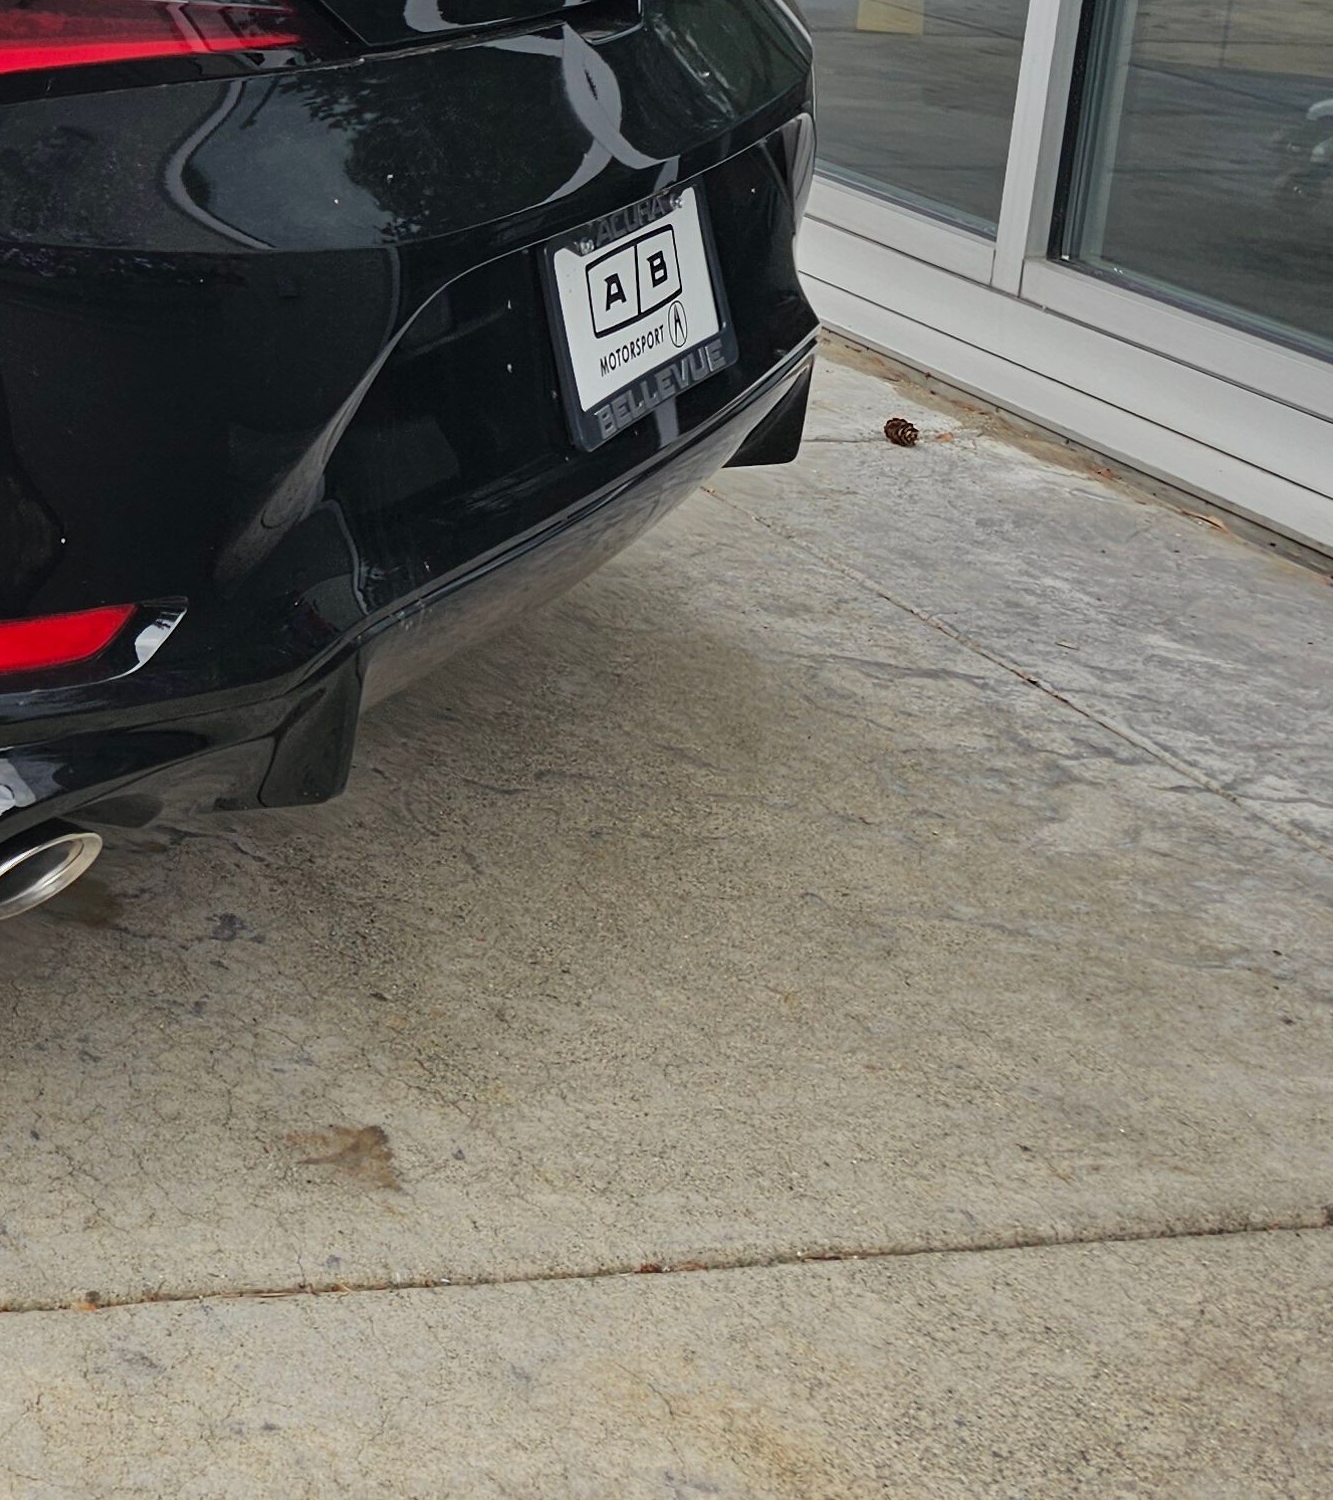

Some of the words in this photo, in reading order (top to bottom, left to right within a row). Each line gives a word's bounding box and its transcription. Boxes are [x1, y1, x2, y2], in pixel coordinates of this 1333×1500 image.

[596, 196, 666, 248] ACURA
[604, 273, 627, 312] A
[646, 250, 669, 288] B
[599, 323, 665, 378] MOTORSPORT
[594, 338, 727, 440] BELLEVUE
